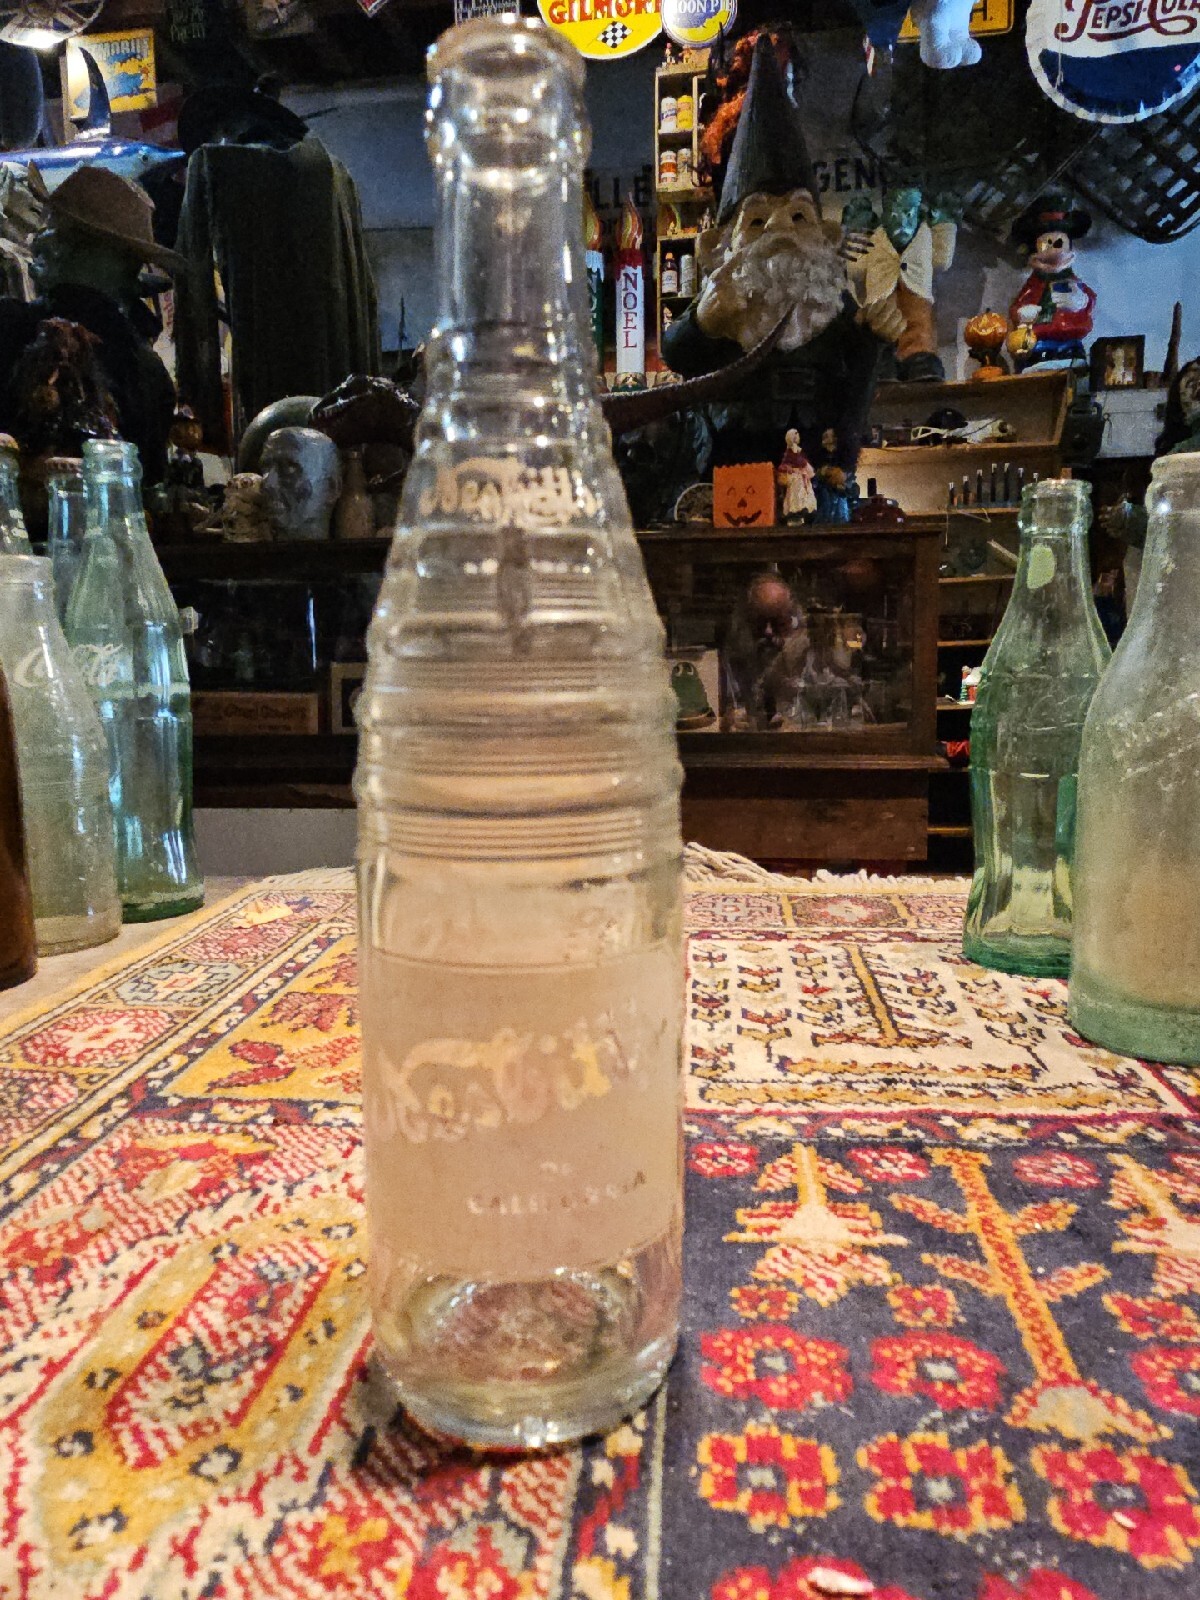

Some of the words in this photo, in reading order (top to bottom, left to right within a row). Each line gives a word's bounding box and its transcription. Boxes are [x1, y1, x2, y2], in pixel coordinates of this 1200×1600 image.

[549, 0, 661, 25] GILMOR
[622, 272, 638, 349] NOEL
[368, 1005, 645, 1142] Nesbit
